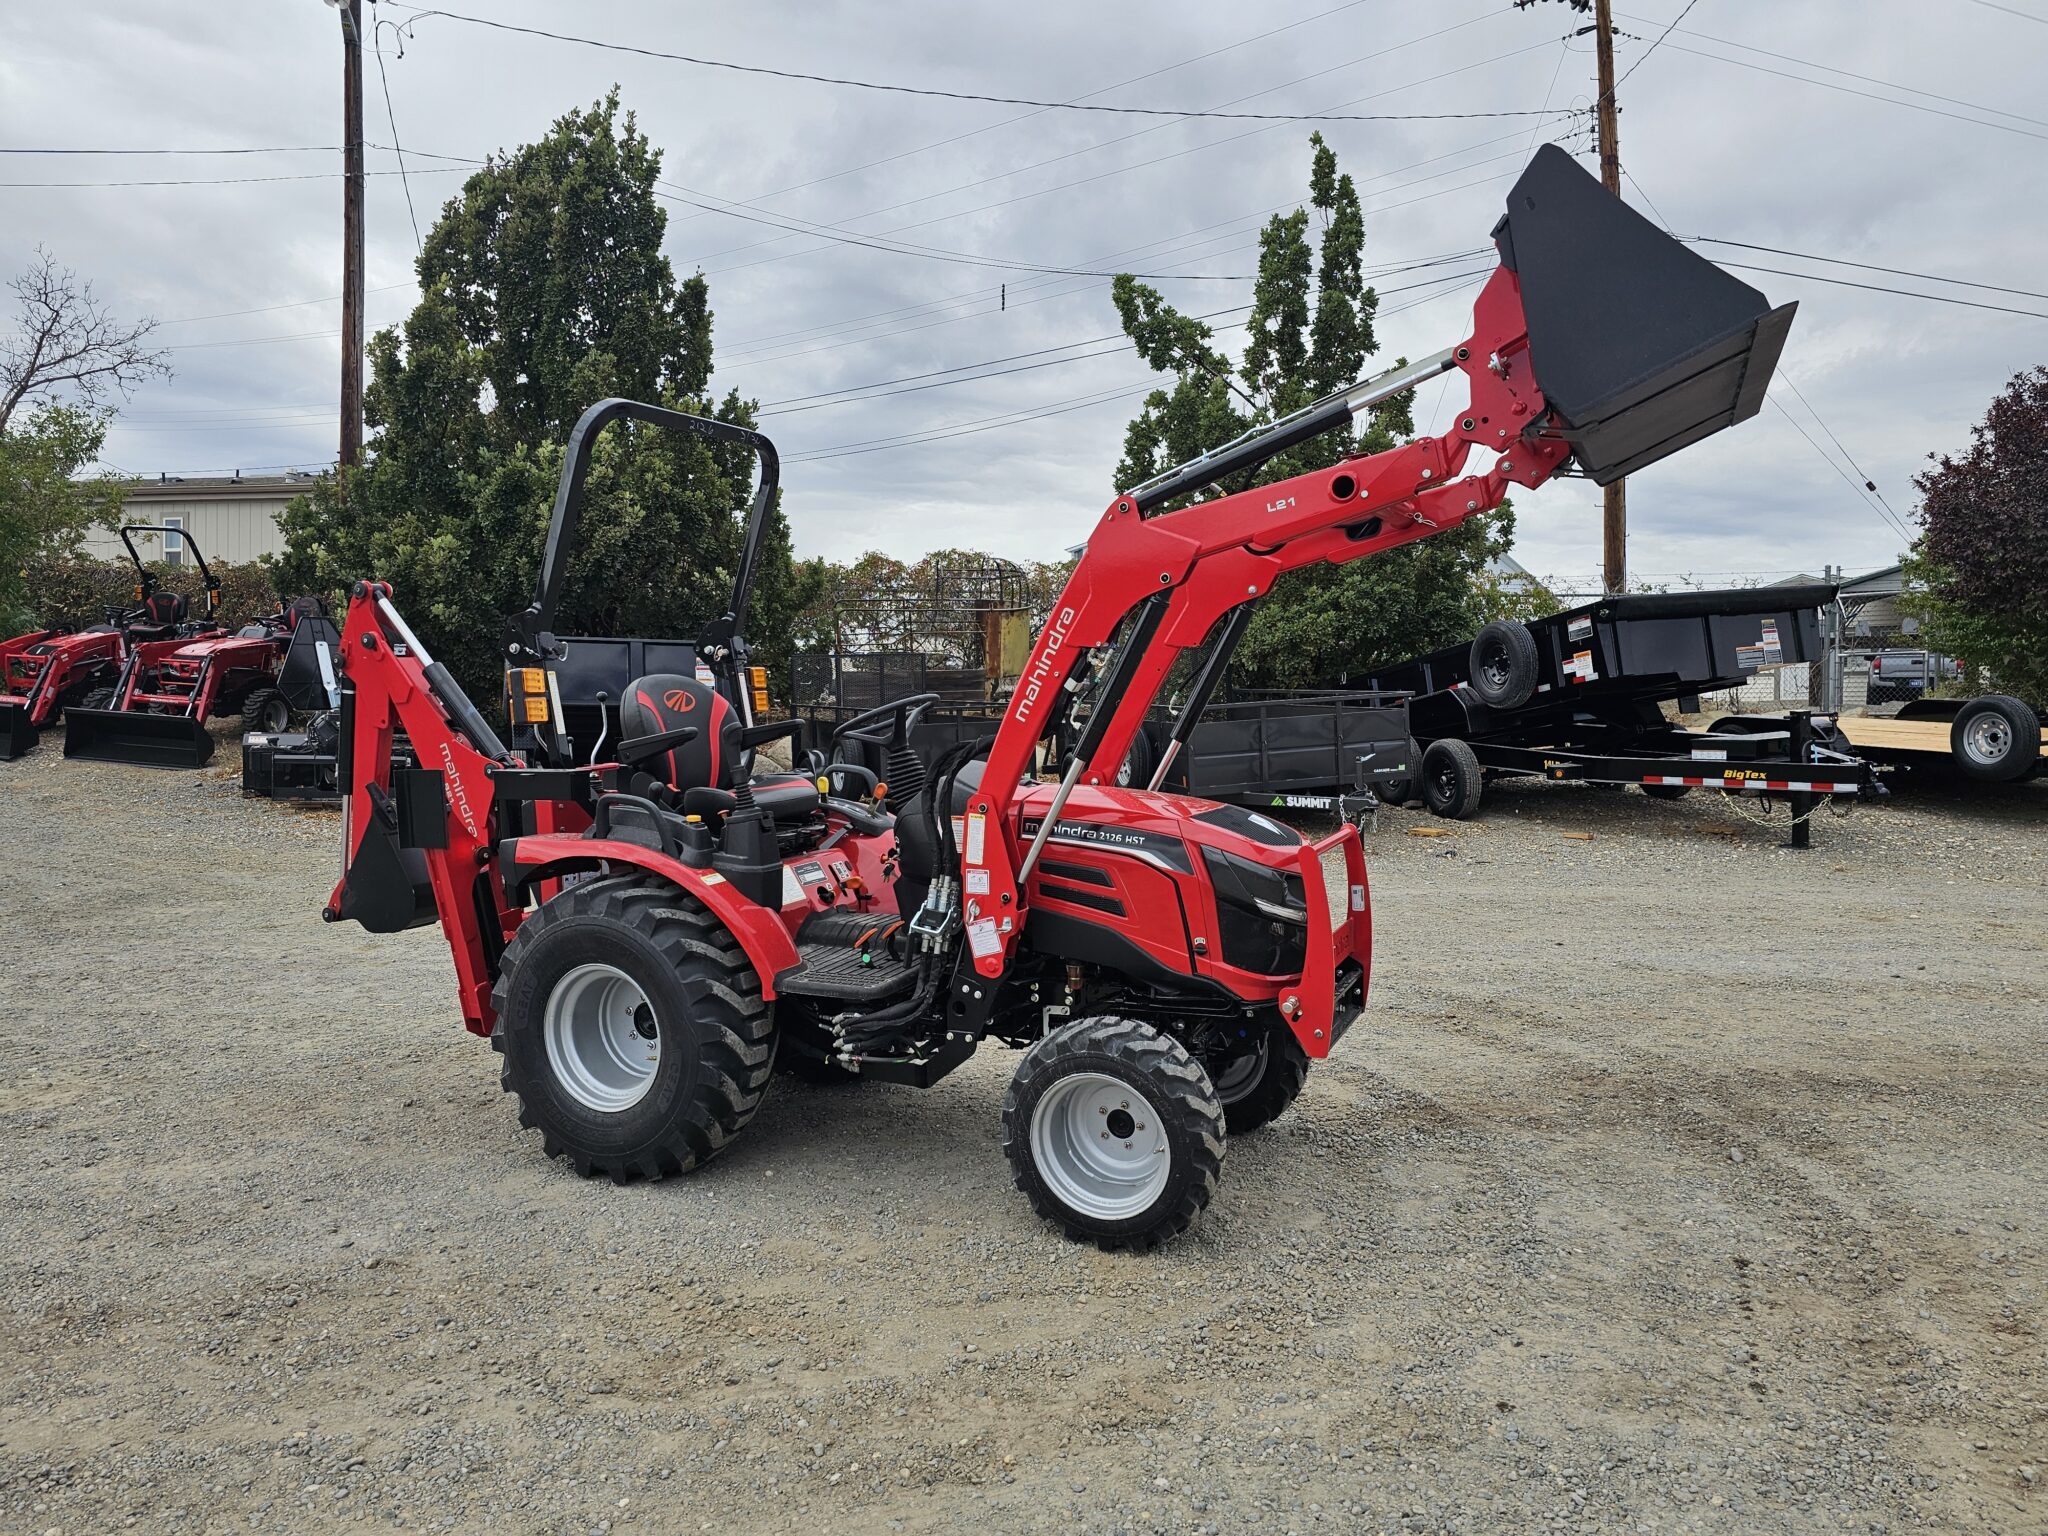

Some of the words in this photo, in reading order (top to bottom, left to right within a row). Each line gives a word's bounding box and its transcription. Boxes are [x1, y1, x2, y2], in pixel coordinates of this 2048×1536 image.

[1266, 496, 1296, 513] L21
[1015, 607, 1075, 723] mahindra
[1723, 769, 1767, 780] BigTex
[439, 742, 478, 838] mahindra
[1286, 796, 1332, 809] SUMMIT
[1099, 831, 1122, 842] 2126
[1125, 836, 1146, 845] HST
